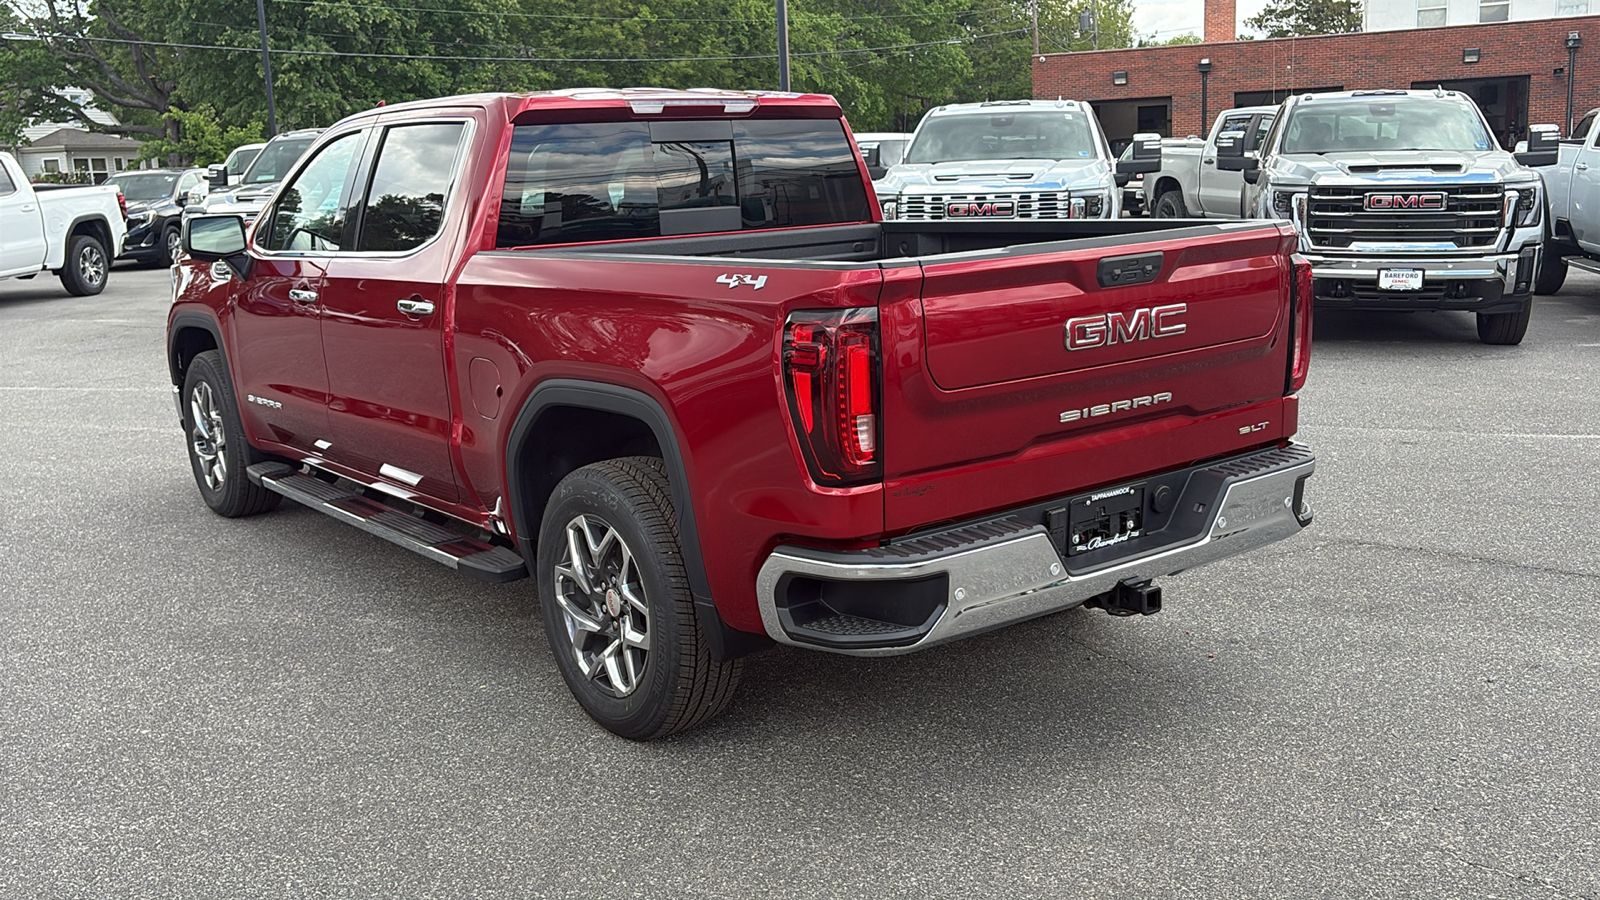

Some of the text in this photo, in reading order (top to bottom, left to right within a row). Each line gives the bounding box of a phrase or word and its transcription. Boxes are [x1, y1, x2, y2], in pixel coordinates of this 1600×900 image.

[949, 203, 1012, 216] GMC
[1371, 195, 1442, 208] GMC
[1064, 303, 1187, 351] GMC
[247, 394, 283, 410] SIERRA
[1059, 391, 1173, 423] SIERRA
[1239, 421, 1270, 435] SLT
[1091, 486, 1130, 501] TAPPAHANNOCK
[1087, 530, 1131, 550] Bareford
[652, 604, 668, 699] BRIDGESTONE
